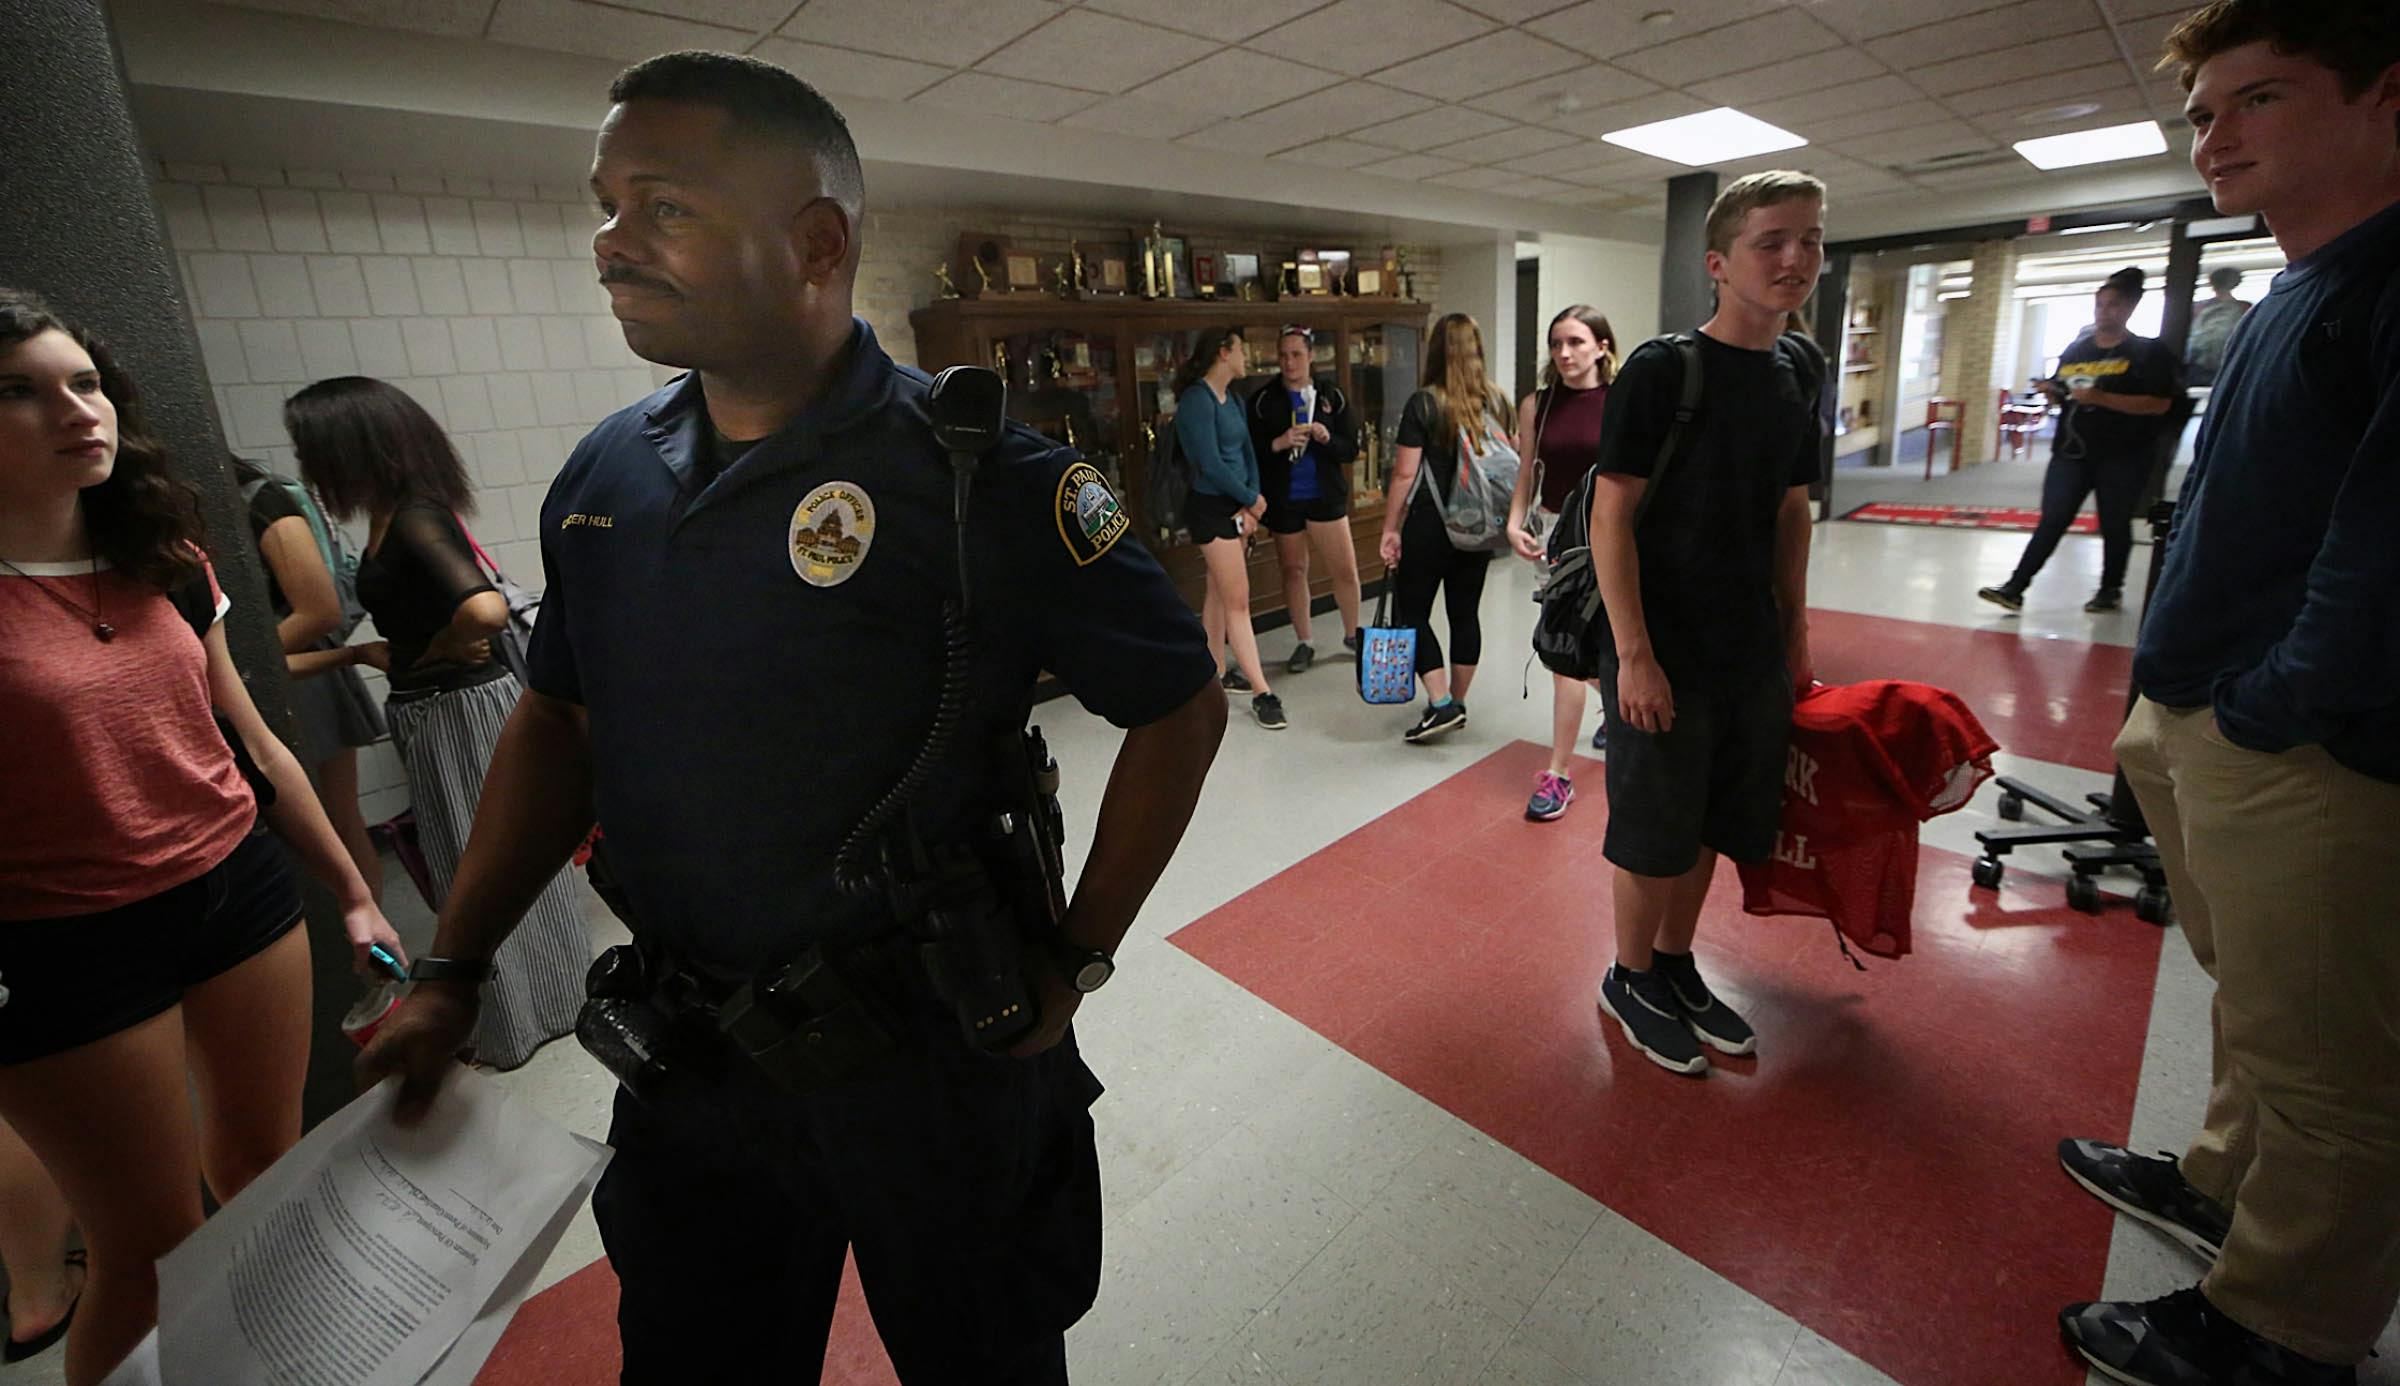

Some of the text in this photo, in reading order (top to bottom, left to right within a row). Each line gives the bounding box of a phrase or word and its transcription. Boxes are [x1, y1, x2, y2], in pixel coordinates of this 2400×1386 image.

[1064, 469, 1102, 513] ST. PAUL
[1090, 510, 1127, 551] POLICE
